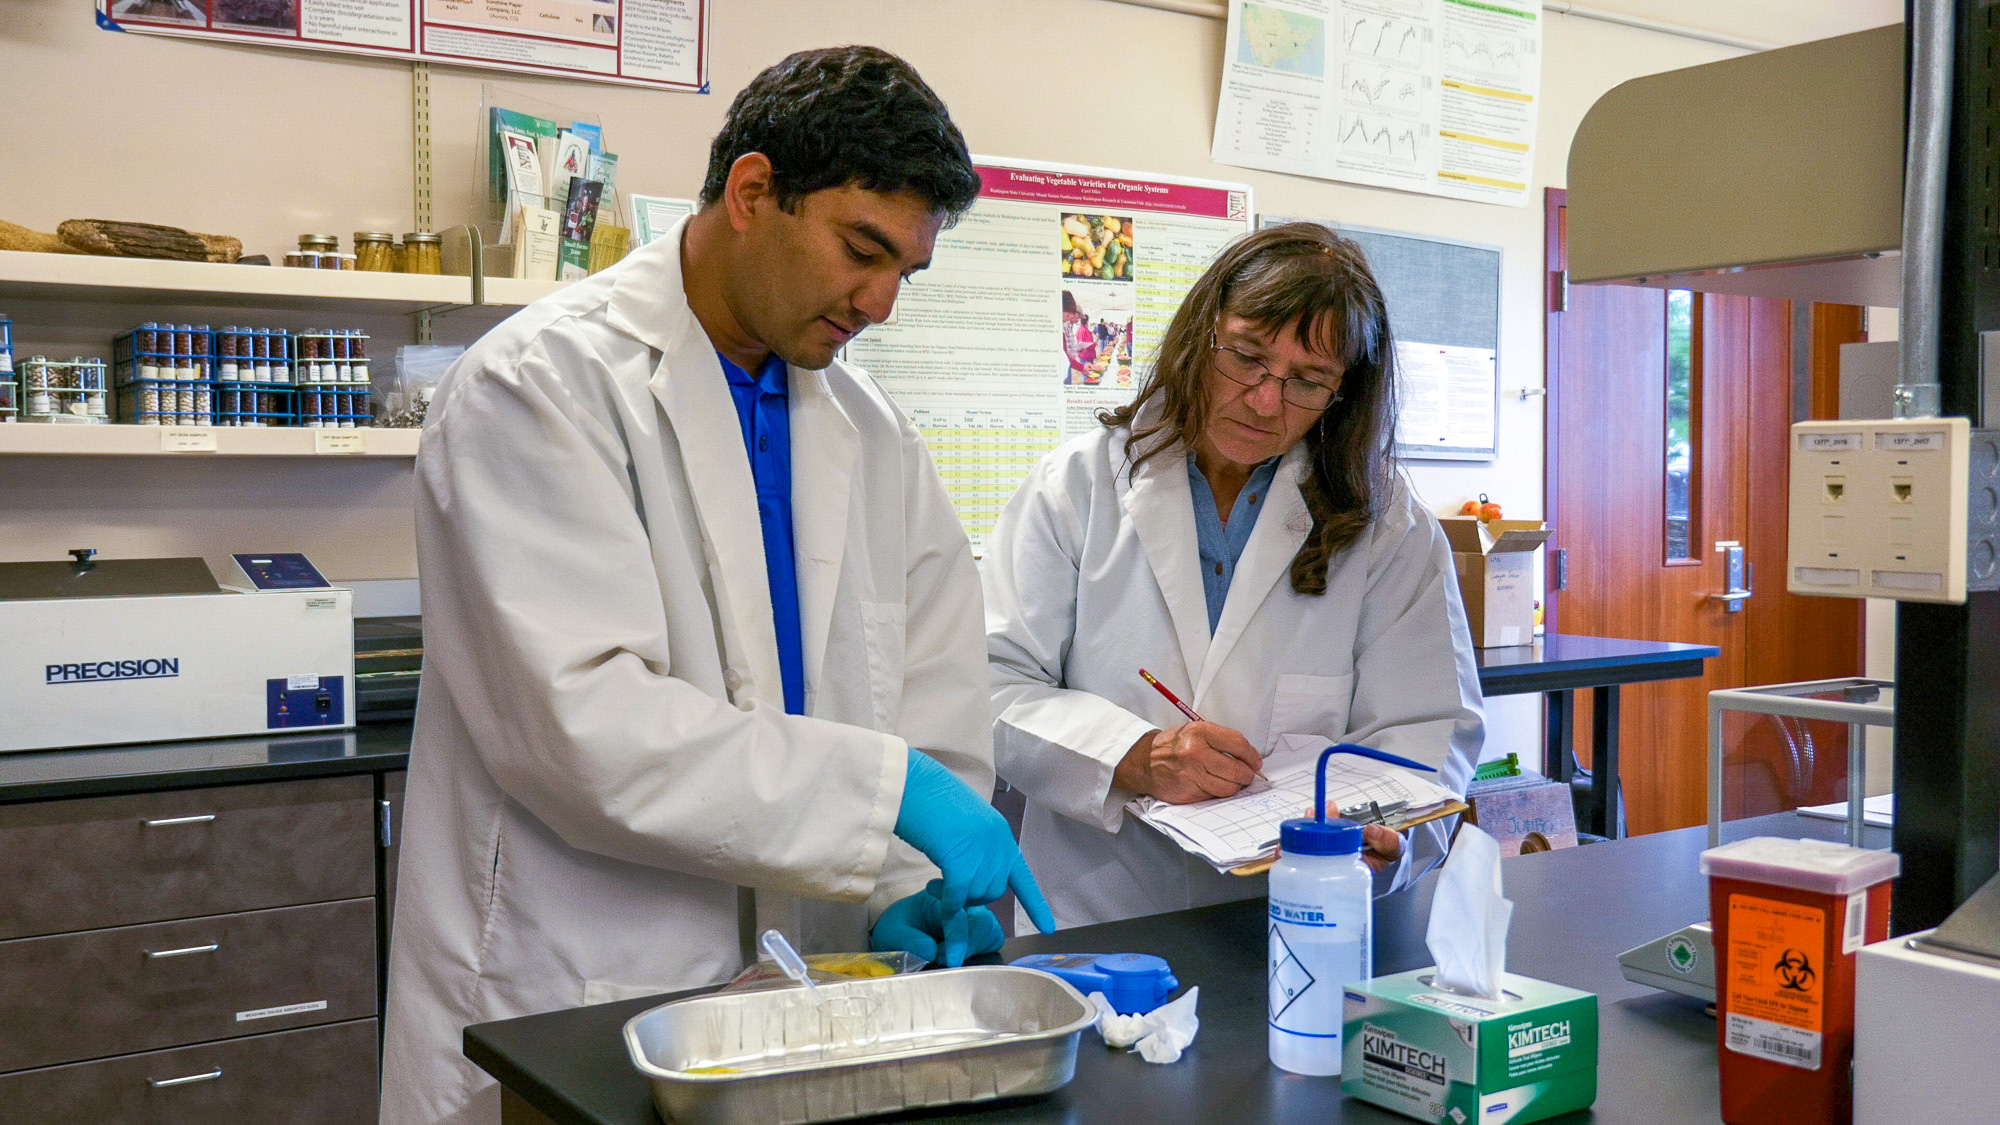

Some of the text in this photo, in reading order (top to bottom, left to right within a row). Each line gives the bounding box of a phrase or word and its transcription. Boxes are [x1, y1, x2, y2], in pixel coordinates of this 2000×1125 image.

[1010, 173, 1169, 195] Evaluating Vegetable Varieties for Organic Systems
[46, 658, 179, 681] PRECISION
[1284, 908, 1325, 922] WATER
[1364, 1024, 1395, 1040] Kimwipes
[1467, 1025, 1473, 1042] 1
[1509, 1020, 1570, 1049] KIMTECH
[1363, 1034, 1445, 1075] KIMTECH
[1363, 1062, 1380, 1072] Delicate
[1391, 1071, 1406, 1081] Wipers
[1405, 1066, 1428, 1080] SCIENCE
